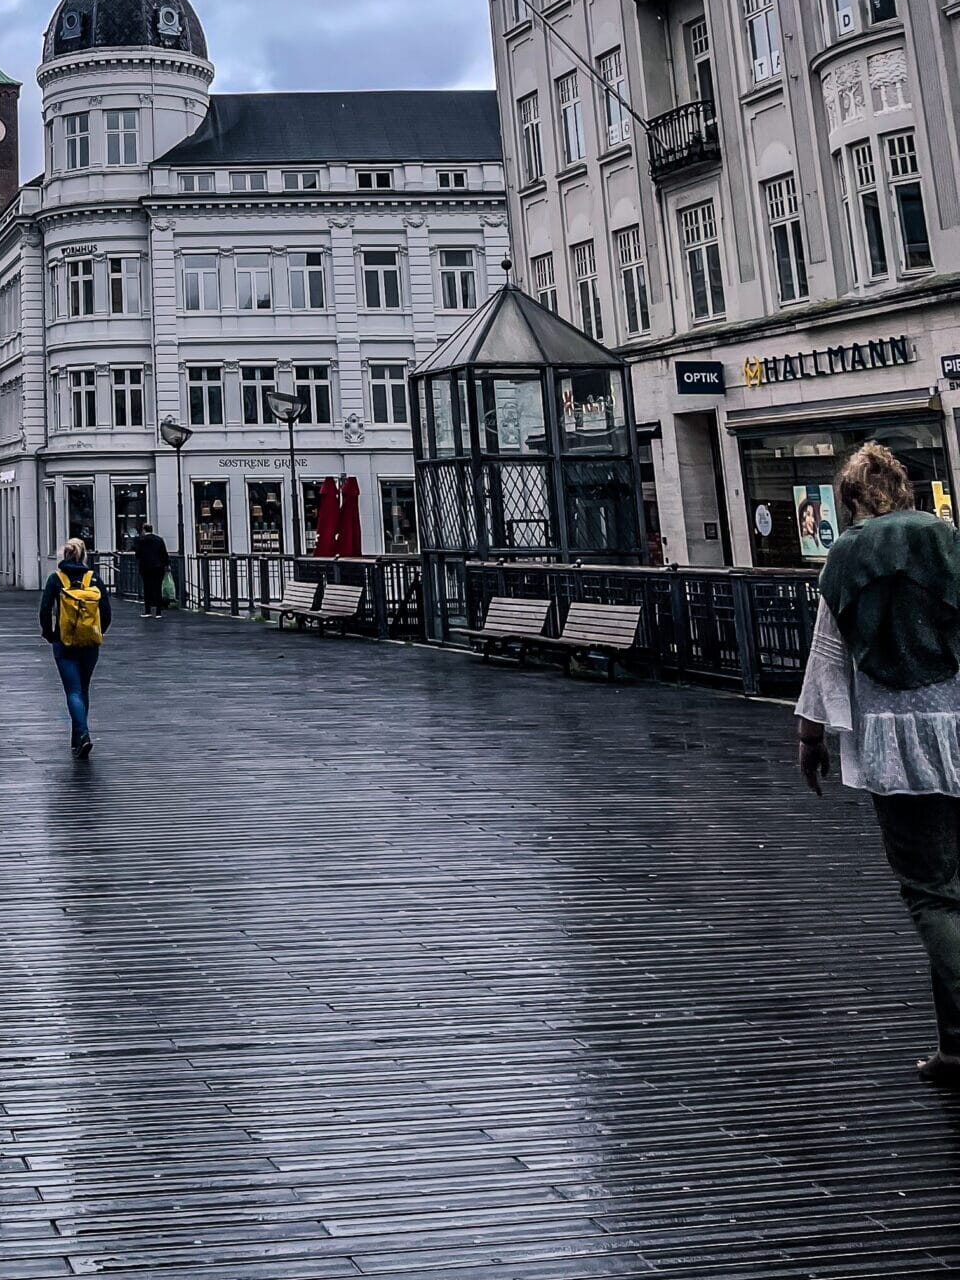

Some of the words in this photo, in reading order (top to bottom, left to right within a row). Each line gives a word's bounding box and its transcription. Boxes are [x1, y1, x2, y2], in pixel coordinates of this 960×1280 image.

[763, 335, 908, 384] HALLMANN
[683, 371, 720, 384] OPTIK
[219, 459, 271, 469] SØSTRENE
